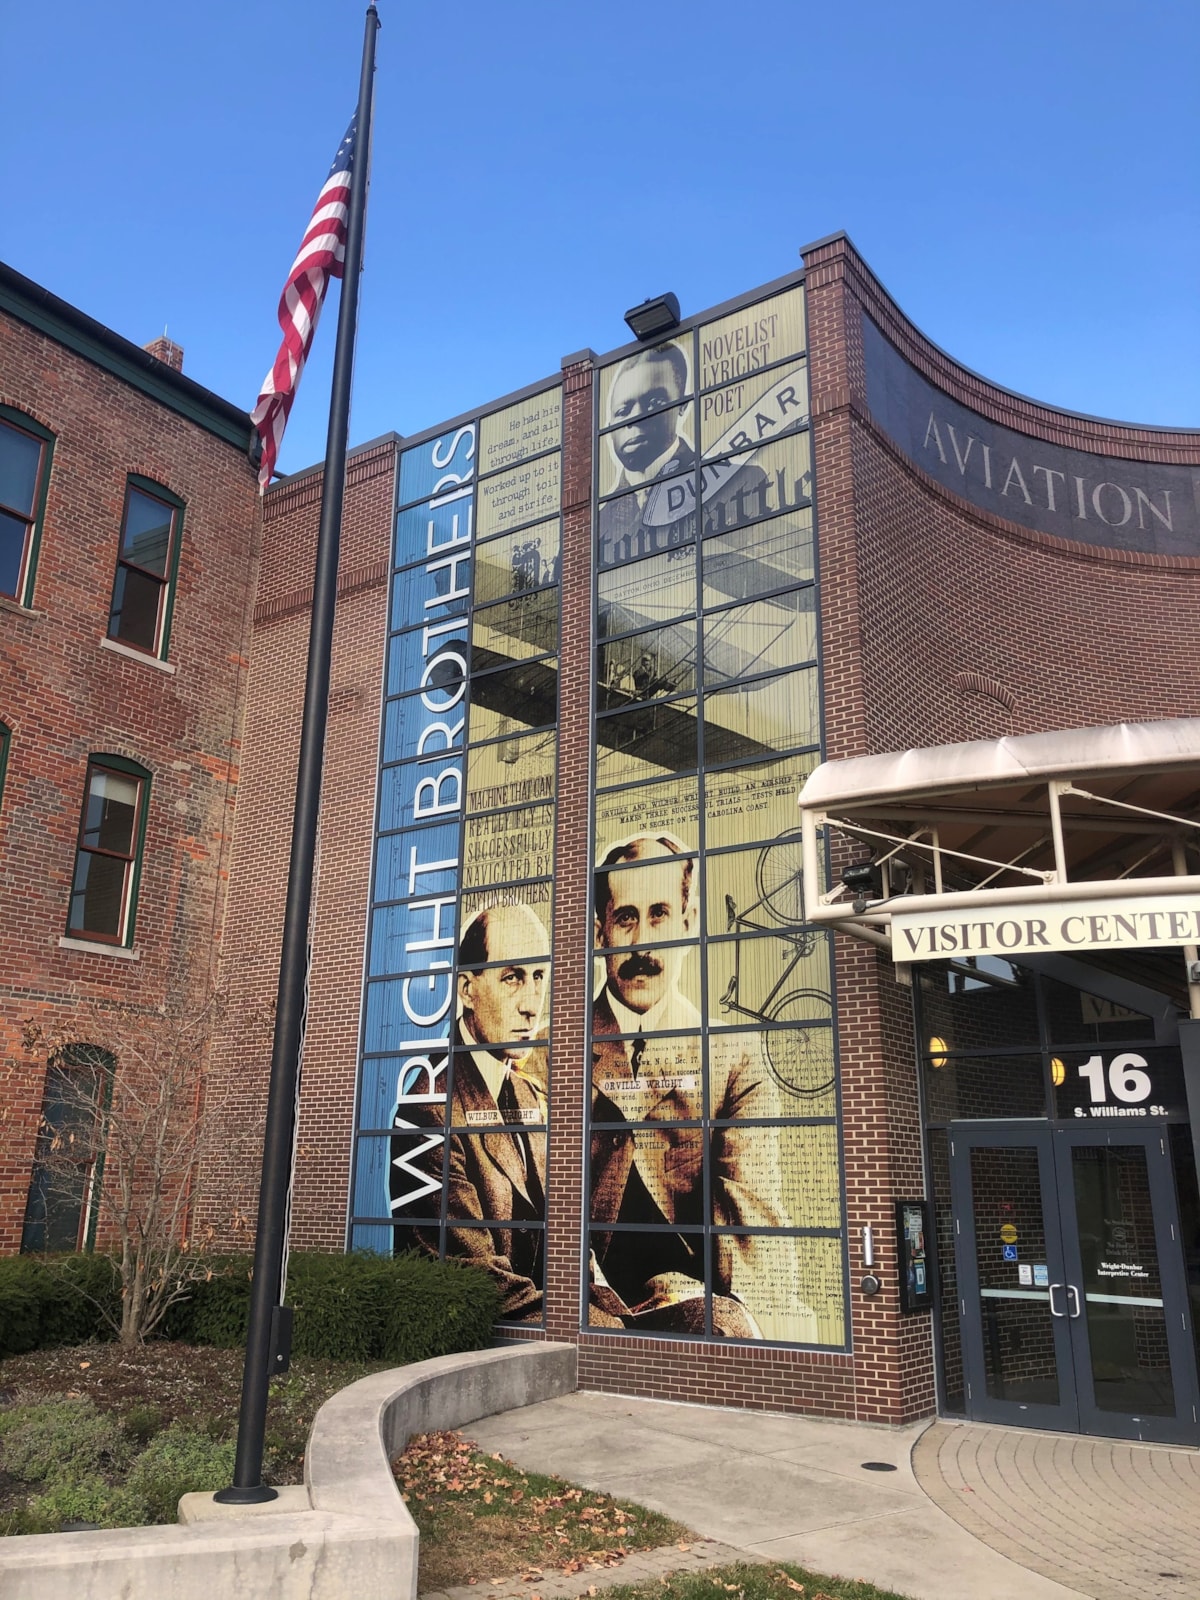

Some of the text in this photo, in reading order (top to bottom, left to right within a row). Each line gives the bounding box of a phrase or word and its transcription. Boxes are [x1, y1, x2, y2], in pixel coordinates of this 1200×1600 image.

[703, 314, 778, 365] NOVELIST
[703, 343, 770, 389] LYRICIST
[508, 405, 560, 431] He had his
[704, 384, 745, 421] POET
[487, 418, 559, 455] dream, and all
[490, 436, 559, 468] through life,
[666, 386, 801, 513] DUNBAR
[483, 461, 559, 496] Worked up to it
[923, 411, 1174, 532] AVIATION
[492, 476, 559, 507] through toil
[498, 494, 557, 520] and strife.
[663, 569, 697, 584] DECEMBE
[413, 423, 475, 819] BROTHERS
[469, 775, 552, 811] MACHINE THAT CAN
[601, 806, 629, 818] ORVILLE
[633, 802, 647, 812] AND
[651, 797, 679, 808] WILBUR
[683, 790, 713, 802] WRIHT
[718, 786, 740, 796] BUILD
[745, 782, 756, 791] AN
[761, 775, 793, 788] AIRSHIP
[620, 786, 796, 824] MAKES THREE SUCCESSUL TRIALS TESTS HELD
[469, 804, 552, 838] REALLY FLY IS
[650, 818, 674, 829] SECRET
[677, 816, 686, 824] ON
[707, 806, 743, 819] CAROLINA
[746, 802, 768, 812] COAST
[468, 828, 551, 863] SUCCESSFULLY
[466, 854, 551, 887] NAVIGATED BY
[465, 881, 550, 914] DAYTON BROTHERS
[902, 919, 1052, 954] VISITOR
[390, 846, 459, 1211] WRIGHT
[604, 1080, 641, 1091] ORVILLE
[1078, 1052, 1152, 1103] 16
[468, 1111, 498, 1121] WILBUR
[1074, 1105, 1169, 1118] S. Williams St.
[1130, 1270, 1150, 1278] Center
